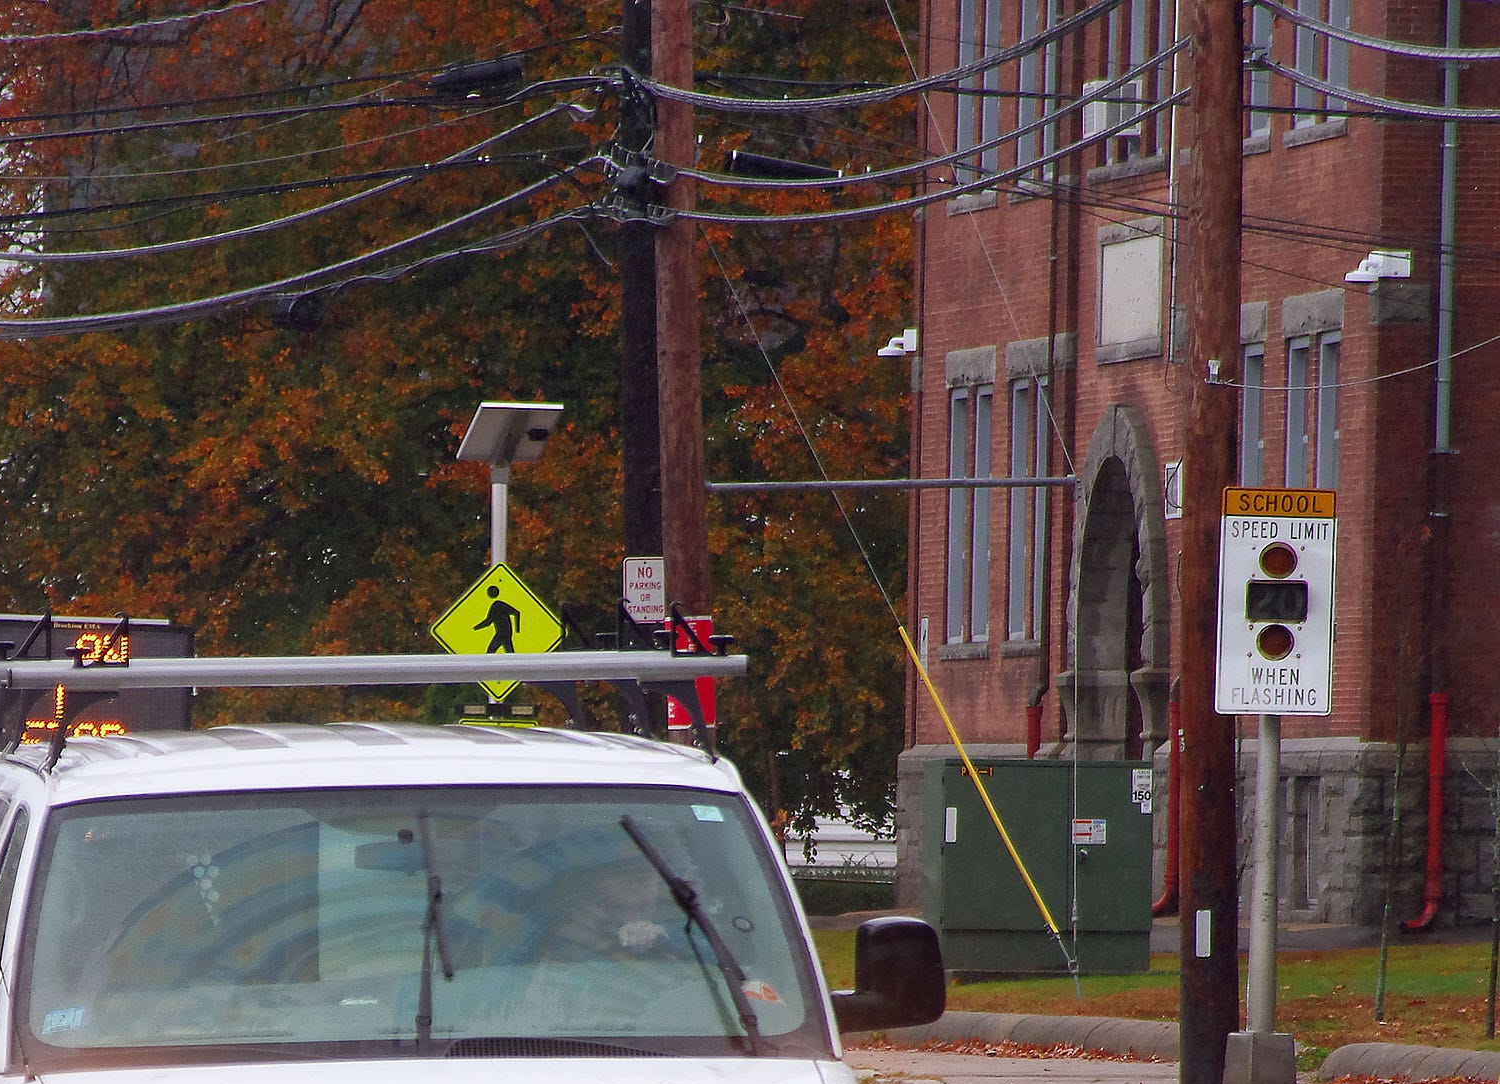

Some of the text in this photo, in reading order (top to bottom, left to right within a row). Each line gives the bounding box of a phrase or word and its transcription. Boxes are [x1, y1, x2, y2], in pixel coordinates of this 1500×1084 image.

[1239, 493, 1323, 514] SCHOOL
[1231, 520, 1329, 540] SPEED LIMIT
[637, 566, 653, 579] NO
[629, 582, 662, 590] PARKING
[627, 604, 664, 614] STANDING
[1251, 667, 1300, 686] WHEN
[1231, 686, 1317, 706] FLASHING
[1132, 790, 1151, 801] 150
